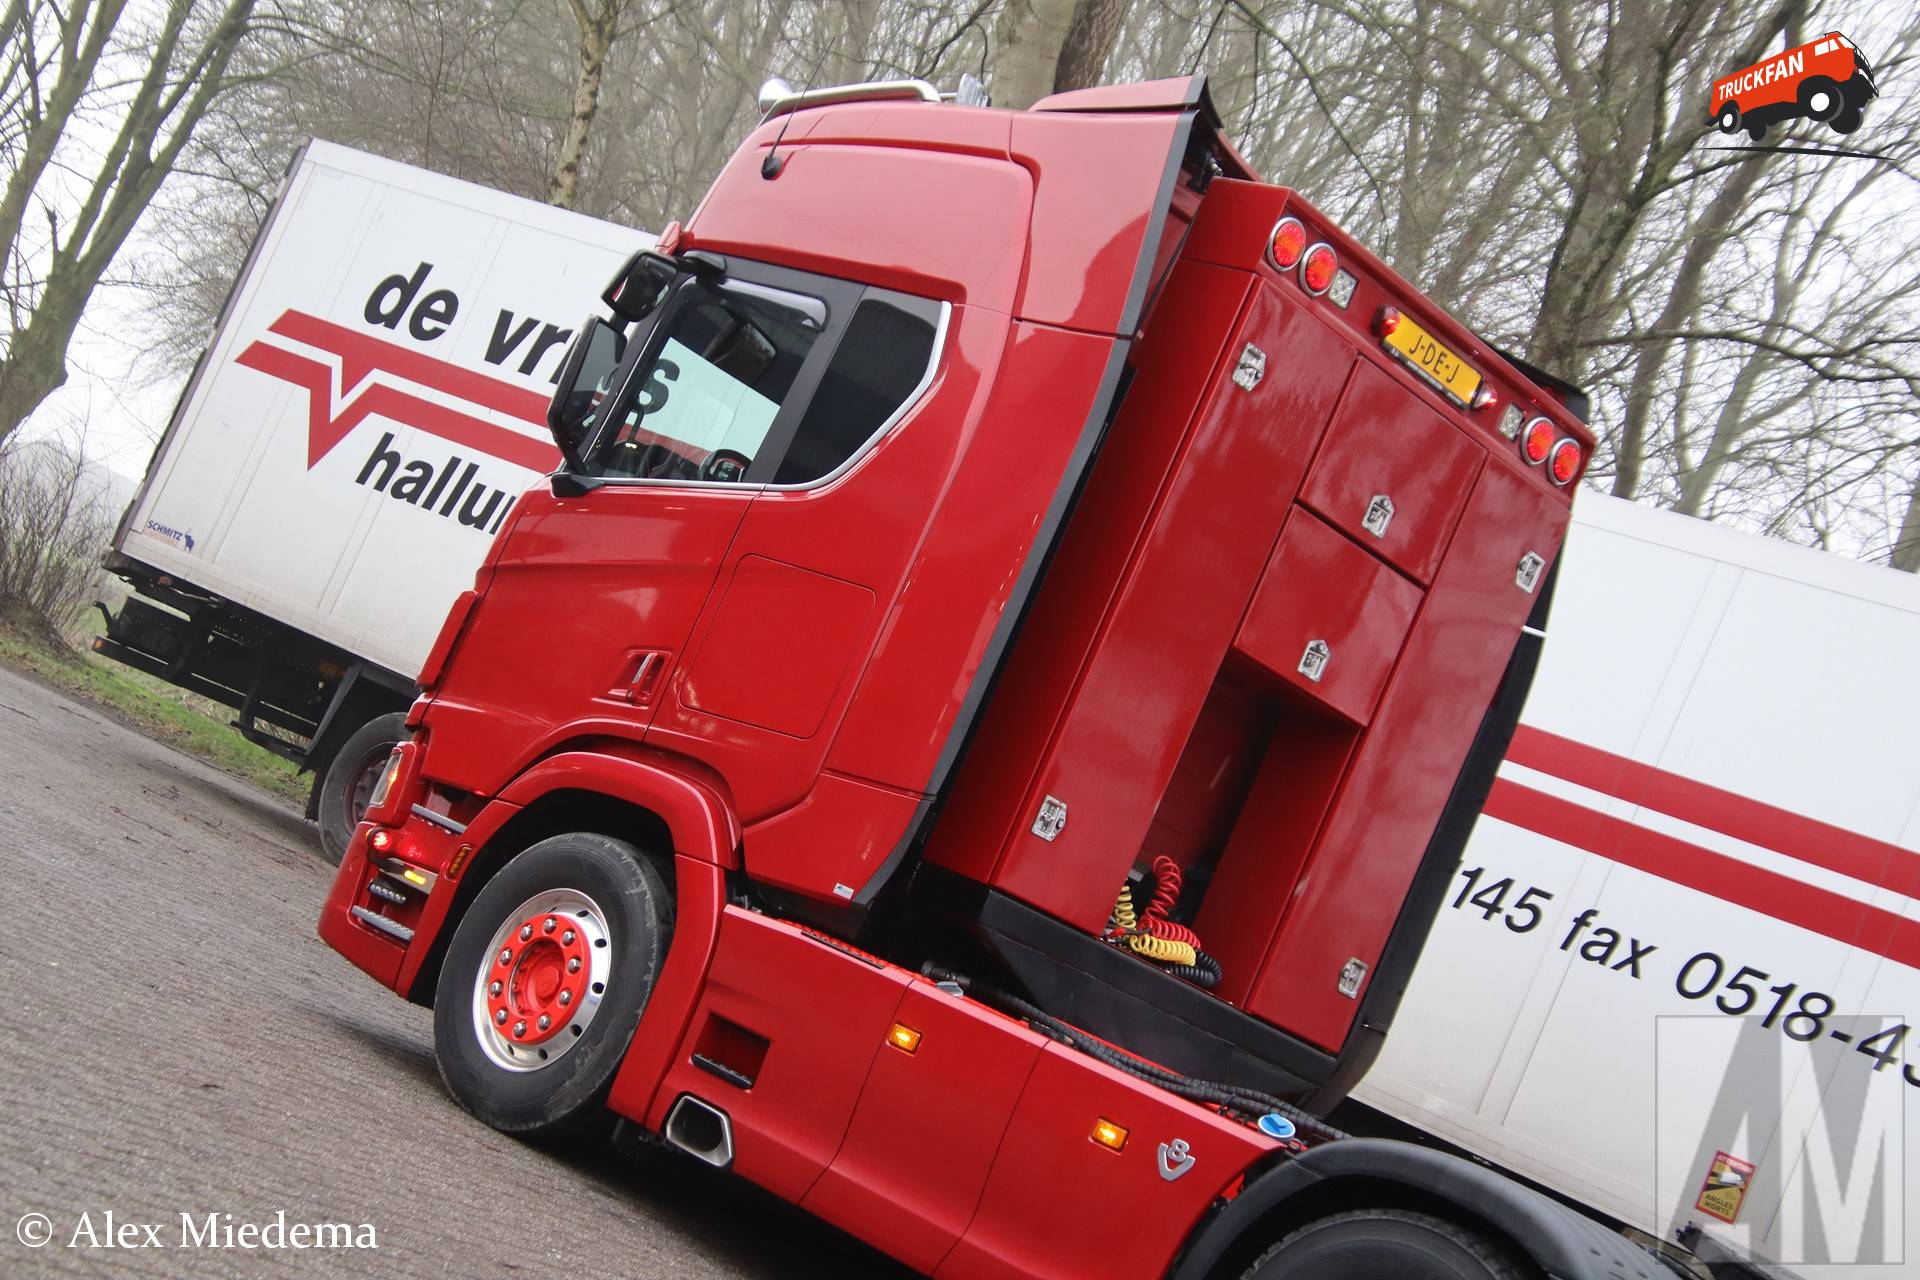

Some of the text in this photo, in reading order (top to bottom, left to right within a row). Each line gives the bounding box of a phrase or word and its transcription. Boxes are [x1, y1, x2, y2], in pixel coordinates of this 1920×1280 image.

[363, 261, 459, 342] de
[1408, 334, 1461, 384] J-DE-J
[146, 520, 183, 541] SCHMITZ
[1452, 861, 1555, 934] 145
[1559, 908, 1658, 980] fax
